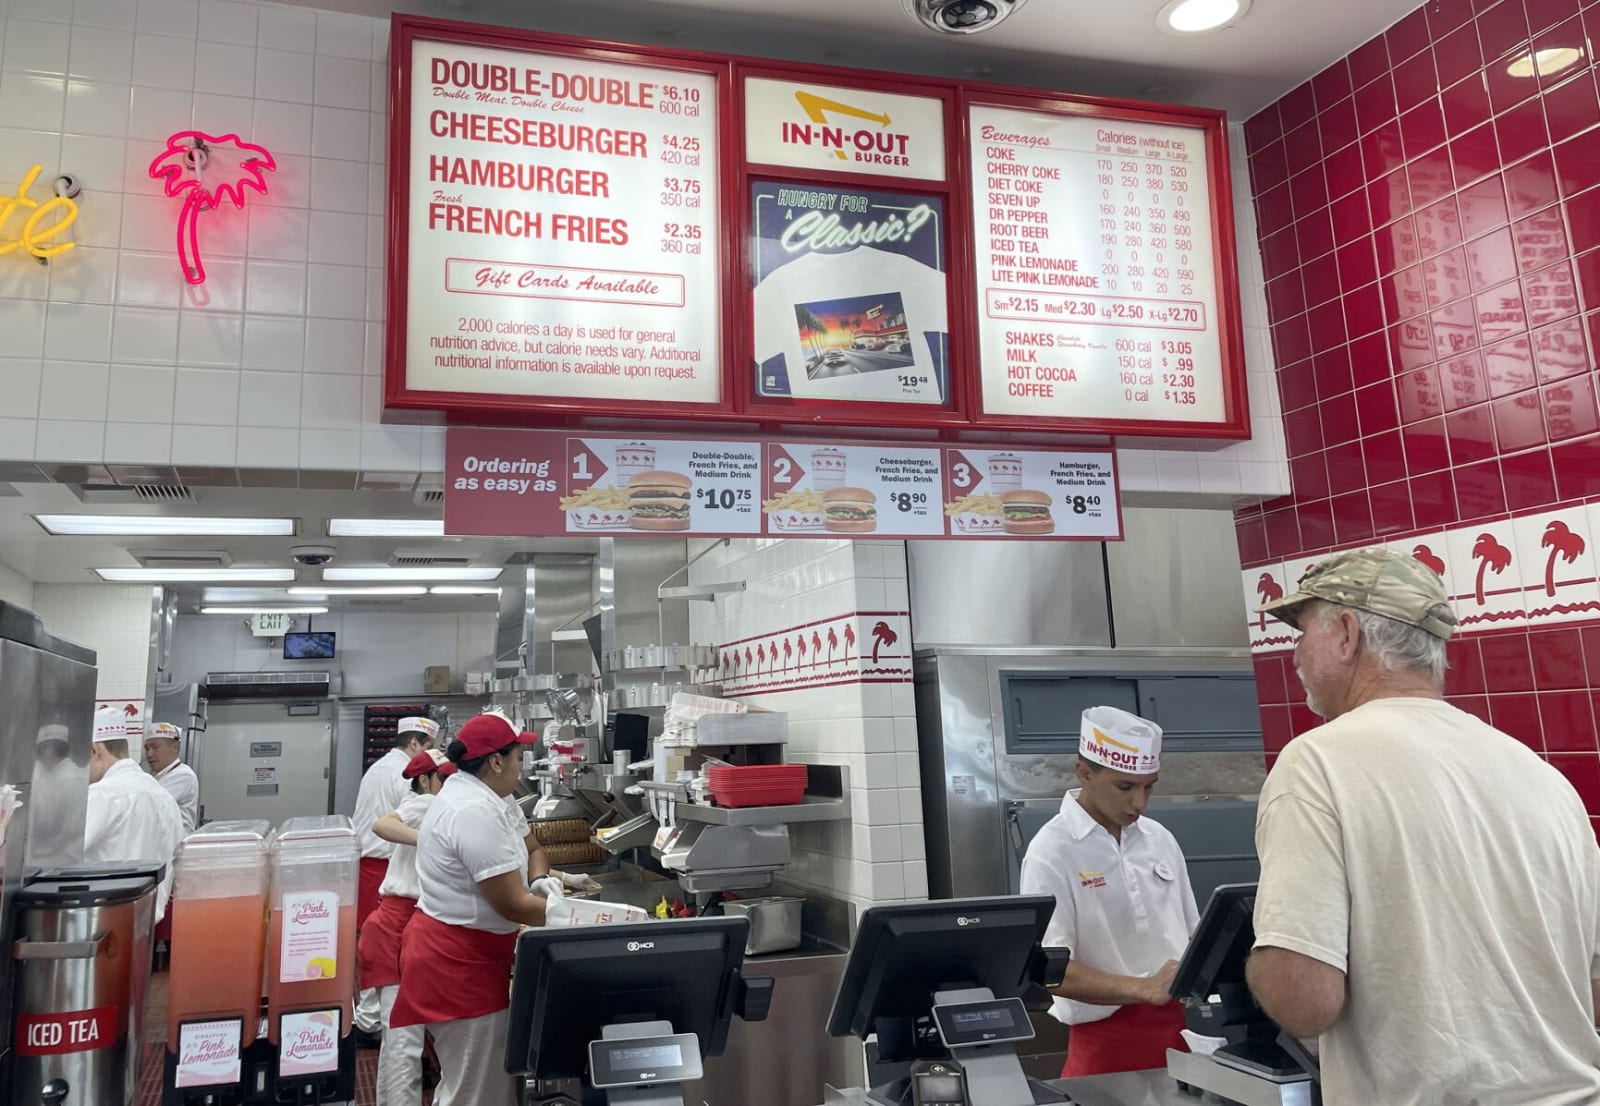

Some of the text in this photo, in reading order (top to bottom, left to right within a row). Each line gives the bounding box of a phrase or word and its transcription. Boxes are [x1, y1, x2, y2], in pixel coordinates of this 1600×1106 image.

[433, 87, 470, 100] Double
[512, 96, 547, 109] Double
[552, 100, 584, 113] Cheese
[663, 85, 700, 102] $6.10
[660, 102, 700, 116] 600 cal
[430, 109, 700, 158] CHEESEBURGER $4.25
[981, 125, 1052, 149] Beverages
[1097, 129, 1136, 146] Calories
[660, 152, 681, 165] 420
[855, 152, 910, 167] BURGER
[986, 146, 1187, 178] COKE 170 250 370 520
[430, 154, 700, 198] HAMBURGER $3.75
[987, 162, 1188, 192] CHERRY COKE 180 250 380 530
[988, 177, 1043, 194] DIET COKE
[432, 190, 462, 204] Fresh
[660, 193, 681, 206] 350
[778, 189, 868, 212] HUNGRY FOR
[988, 192, 1022, 206] SEVEN
[1026, 195, 1040, 208] UP
[1124, 206, 1140, 218] 240
[1173, 210, 1190, 222] 490
[428, 203, 701, 246] FRENCH FRIES $2.35
[785, 209, 793, 220] A
[990, 208, 1048, 224] DR PEPPER
[781, 204, 931, 252] Classic?
[990, 223, 1049, 240] ROOT BEER
[660, 240, 682, 254] 360
[990, 238, 1040, 254] ICED TEA
[992, 254, 1078, 272] PINK LEMONADE
[474, 267, 659, 296] Gift Cards Available
[992, 270, 1100, 288] LITE PINK LEMONADE
[994, 297, 1198, 322] Sm $2.15 Med $2.30 Lg $2.50 X-Lg $2.70
[458, 318, 676, 344] 2,000 calories a day is used for general
[430, 336, 477, 350] nutrition
[524, 340, 542, 354] but
[546, 340, 582, 356] calorie
[585, 343, 618, 358] needs
[650, 346, 701, 362] Additional
[1006, 332, 1054, 347] SHAKES
[1116, 339, 1136, 352] 600
[1161, 340, 1192, 355] $3.05
[434, 354, 696, 382] nutritional information is available upon request.
[1006, 348, 1037, 362] MILK
[1118, 356, 1136, 368] 150
[1008, 366, 1194, 388] HOT COCOA 160 $2.30
[1008, 382, 1196, 405] COFFEE 0 cal $1.35
[463, 456, 551, 478] Ordering
[572, 452, 593, 480] 1
[688, 460, 718, 470] French
[742, 462, 758, 470] and
[695, 469, 752, 480] Medium Drink
[773, 458, 792, 484] 2
[875, 466, 900, 474] French
[952, 462, 972, 488] 3
[1050, 470, 1074, 478] French
[454, 478, 558, 496] as easy as
[881, 475, 933, 484] Medium Drink
[1056, 478, 1106, 486] Medium Drink
[292, 908, 330, 925] Lemonade
[302, 901, 324, 914] Pink
[27, 1017, 99, 1046] ICED TEA
[300, 1029, 326, 1044] Pink
[199, 1037, 225, 1052] Pink
[286, 1037, 334, 1060] Lemonade
[182, 1045, 237, 1065] Lemonade
